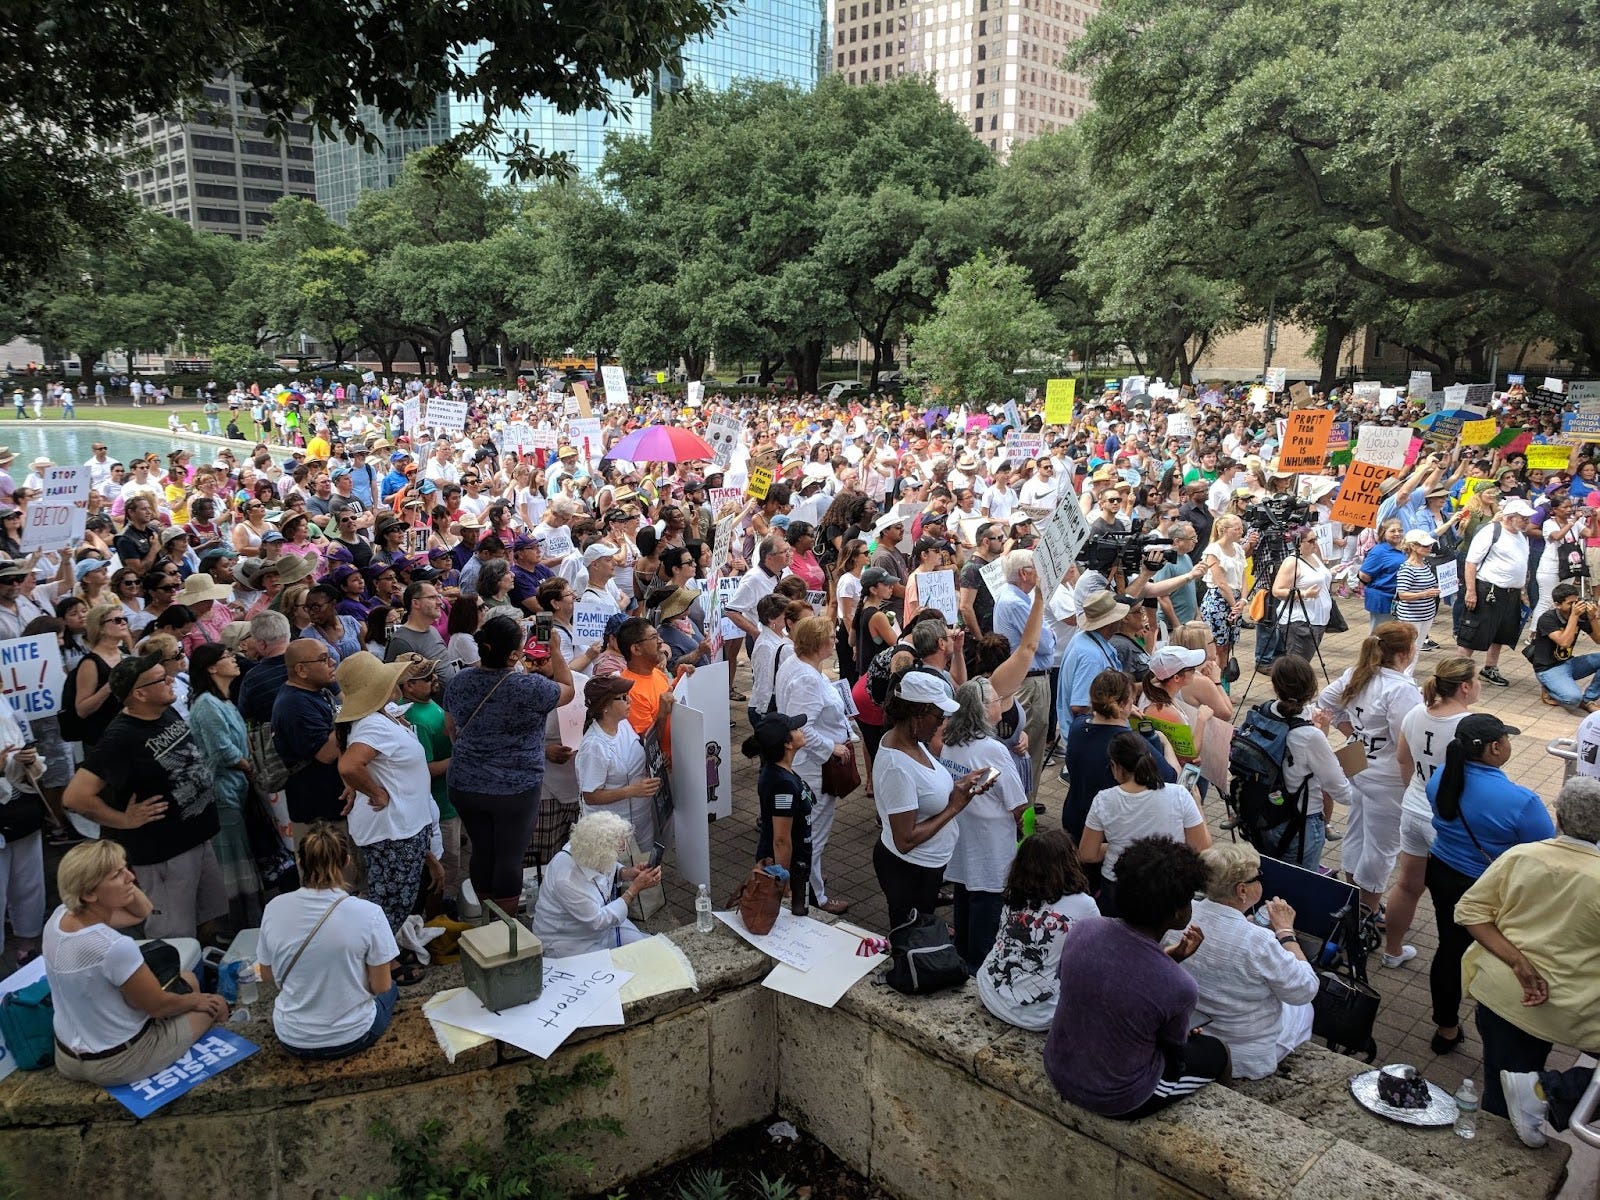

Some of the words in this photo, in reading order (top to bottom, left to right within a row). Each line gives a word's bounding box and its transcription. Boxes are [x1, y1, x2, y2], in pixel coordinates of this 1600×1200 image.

[1294, 414, 1325, 425] PROFIT
[1569, 419, 1600, 427] DIGNIDA
[1292, 436, 1313, 445] PAIN
[1300, 447, 1306, 455] IS
[51, 470, 76, 479] STOP
[1353, 464, 1396, 481] LOCK
[46, 485, 78, 496] FAMILY
[1361, 480, 1380, 492] UP
[711, 488, 741, 498] TAKEN
[33, 506, 69, 526] BETO
[926, 573, 943, 584] STOP
[577, 612, 611, 623] FAMILIE
[577, 629, 605, 637] TOGET
[2, 642, 39, 665] NITE
[1423, 731, 1434, 756] I
[537, 969, 615, 1029] Support
[143, 1038, 238, 1101] RESIST
